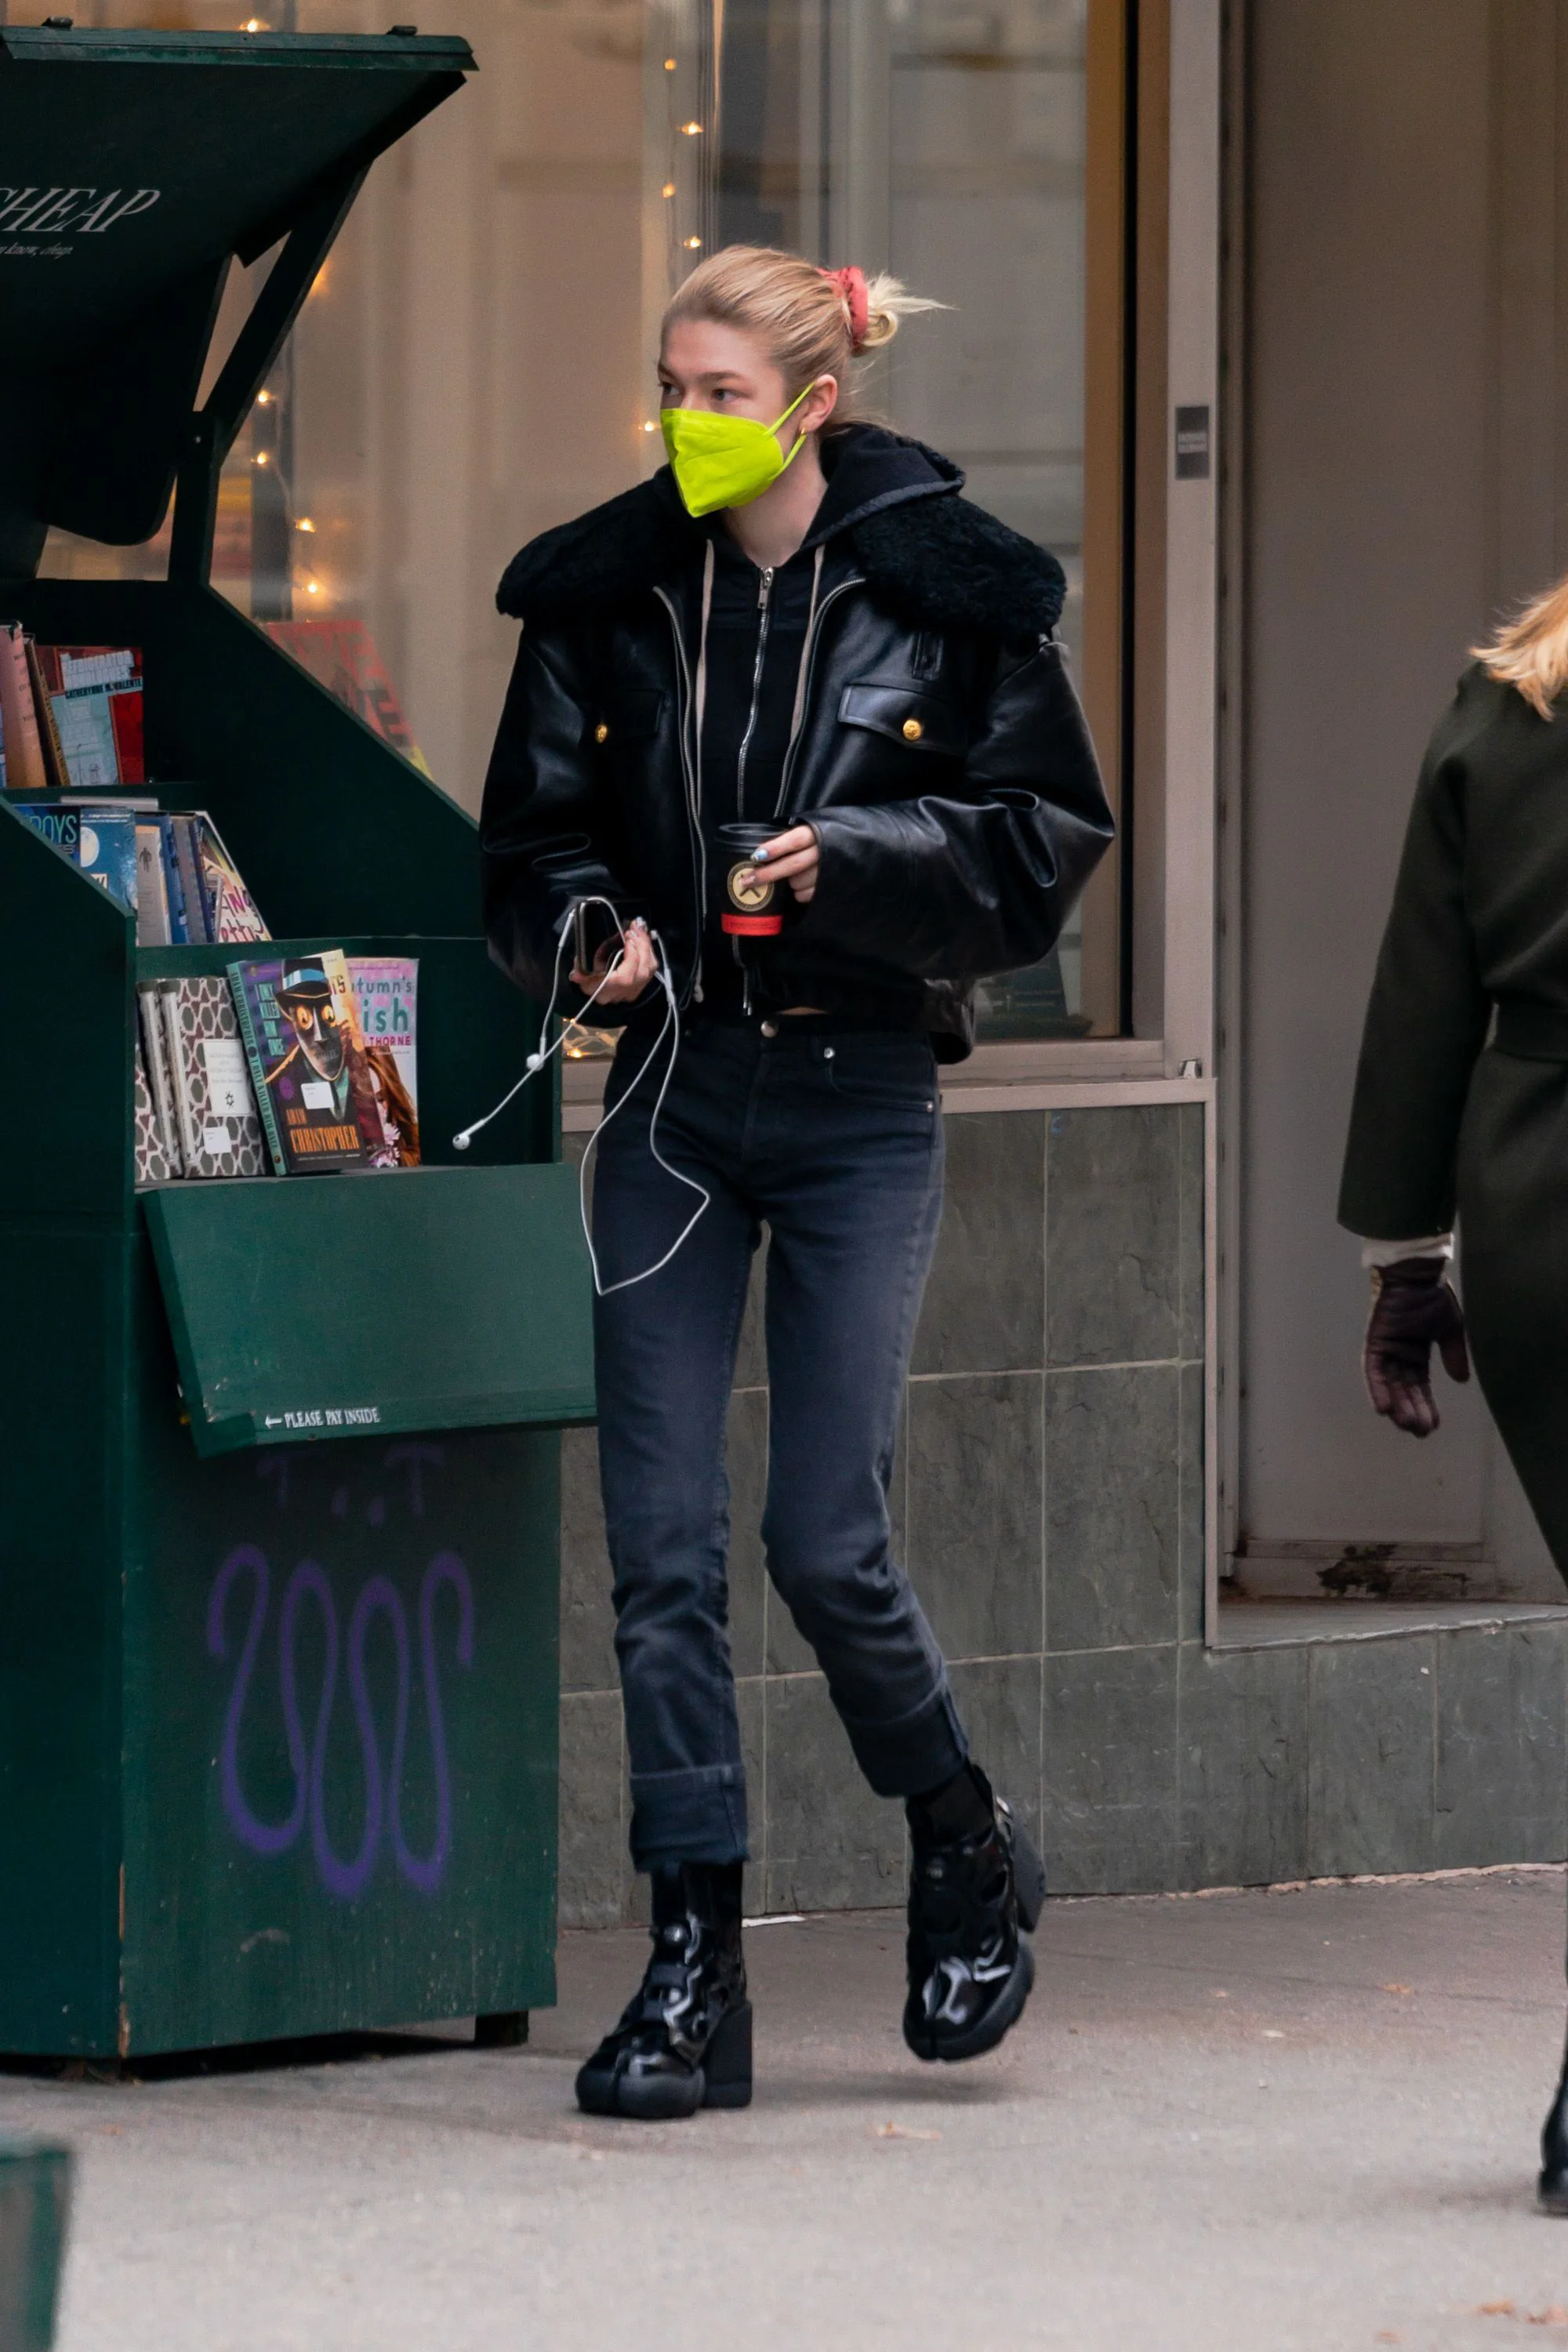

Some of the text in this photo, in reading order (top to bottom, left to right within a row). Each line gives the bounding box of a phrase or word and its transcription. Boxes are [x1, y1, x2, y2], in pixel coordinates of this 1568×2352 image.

[369, 1036, 412, 1046] THORNE
[290, 1121, 359, 1154] CHRISTOPHER
[284, 1406, 380, 1428] PLEASE PAY INSIDE
